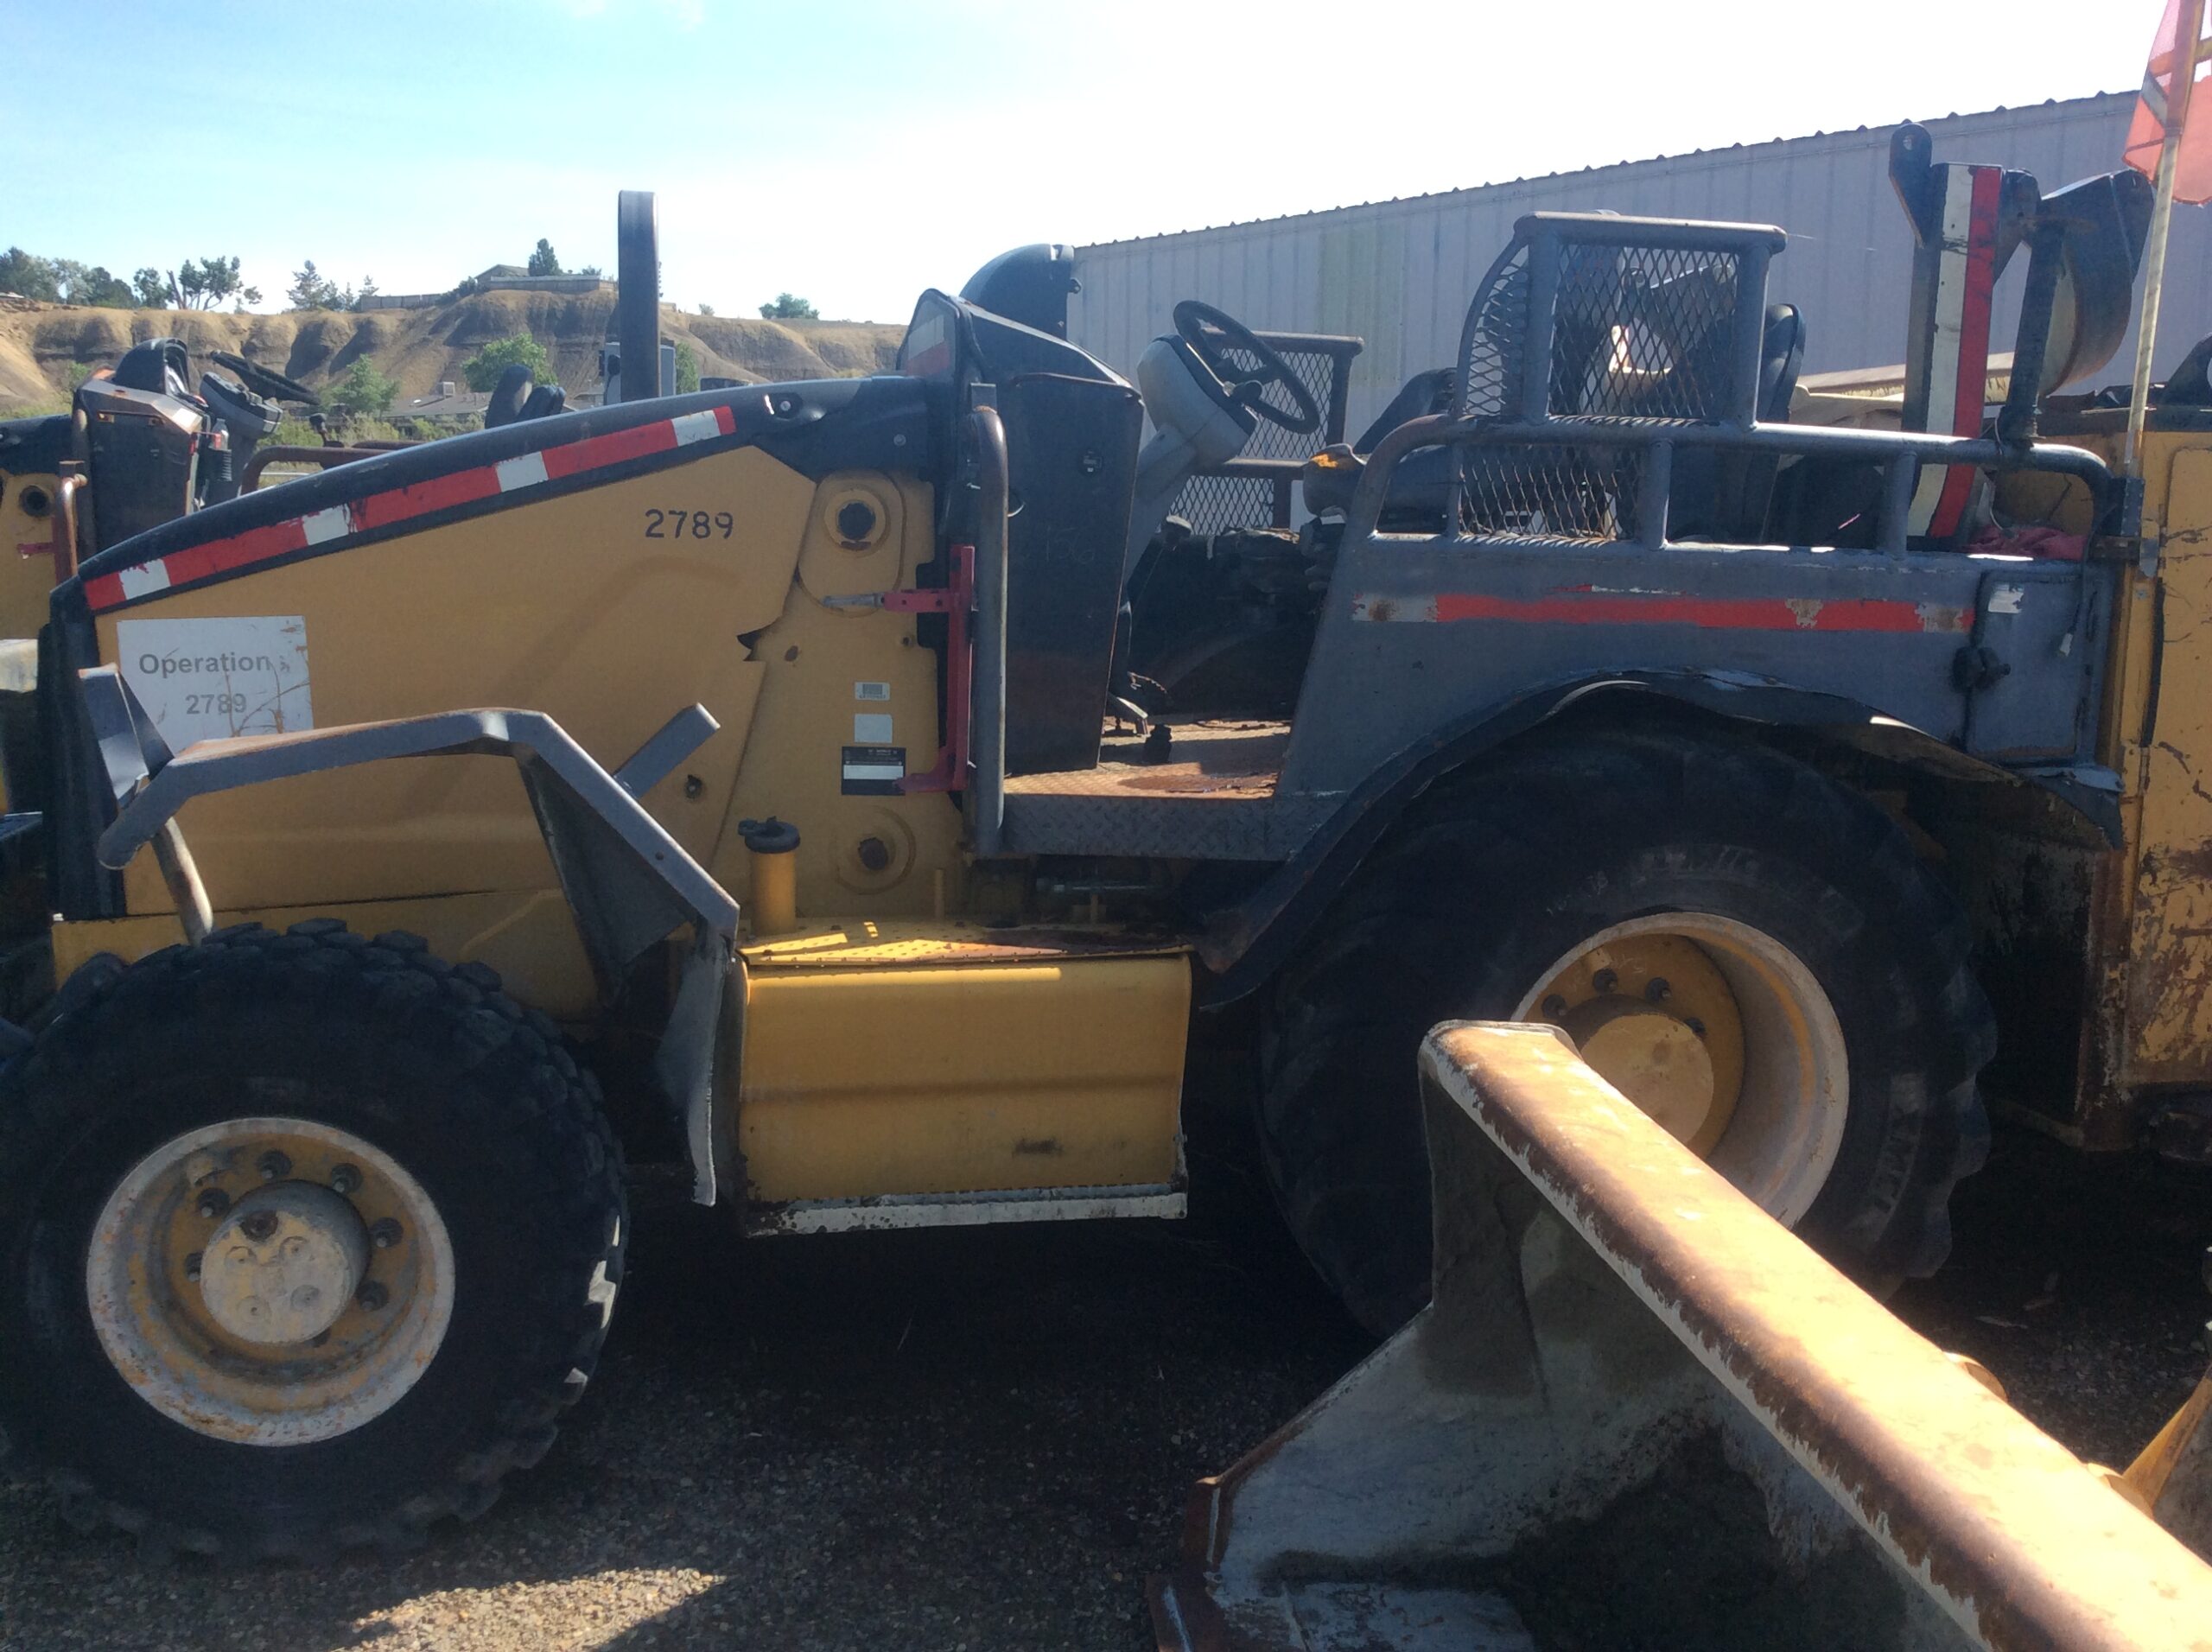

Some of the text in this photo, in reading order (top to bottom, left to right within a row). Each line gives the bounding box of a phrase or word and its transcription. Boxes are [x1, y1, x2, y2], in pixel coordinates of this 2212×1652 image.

[645, 508, 734, 540] 2789
[139, 652, 270, 678] Operation
[186, 693, 247, 715] 2789
